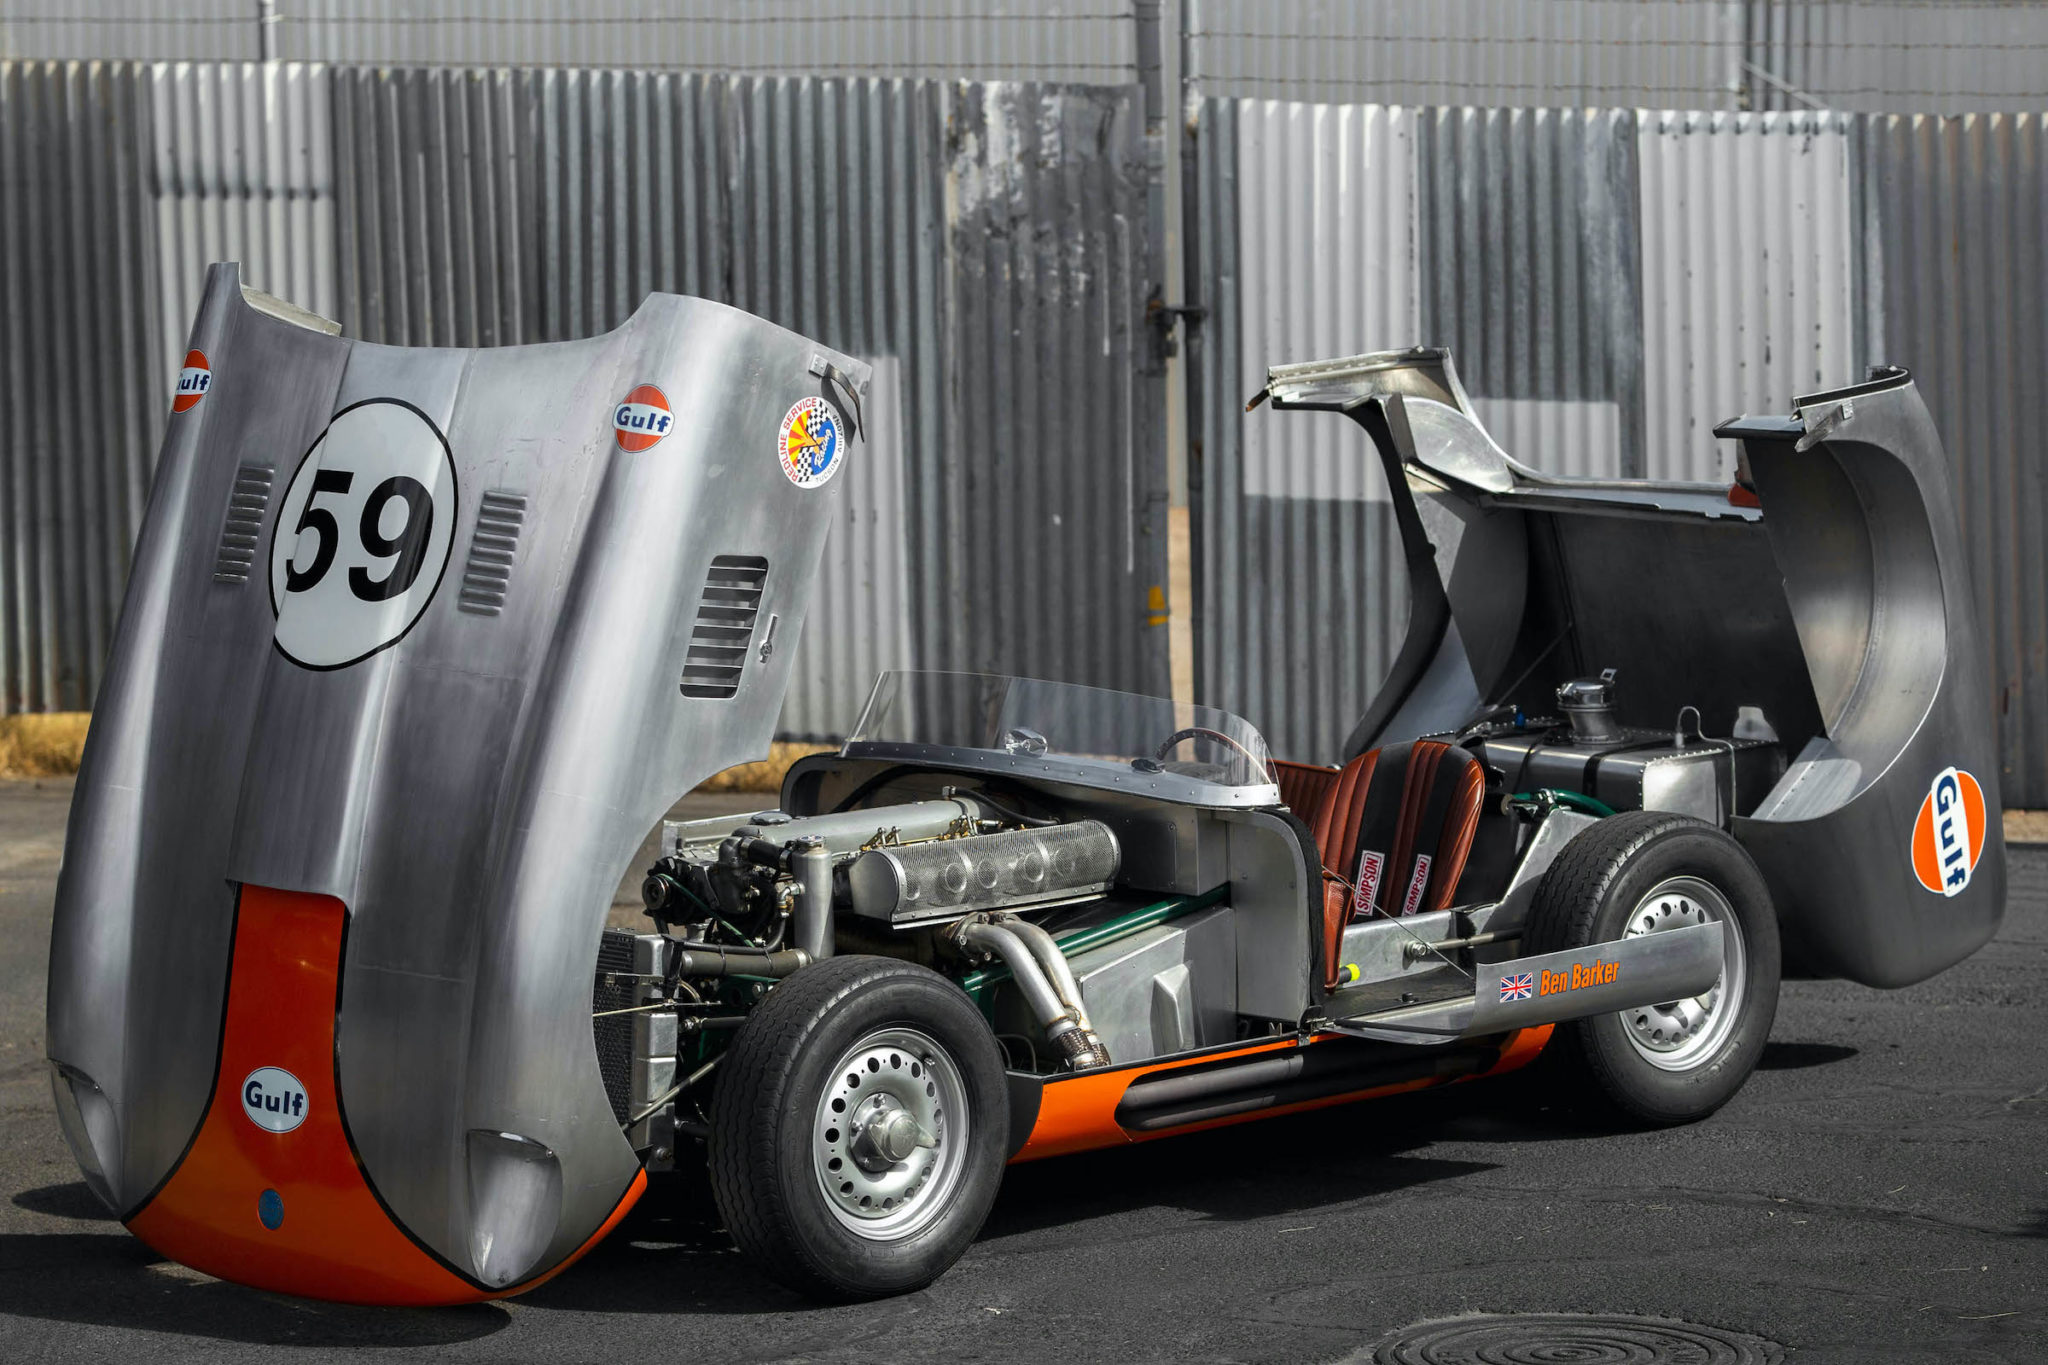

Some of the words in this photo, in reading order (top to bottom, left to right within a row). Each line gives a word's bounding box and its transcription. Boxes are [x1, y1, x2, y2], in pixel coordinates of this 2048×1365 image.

[177, 374, 210, 391] ulf
[616, 406, 671, 433] Gulf
[783, 397, 817, 430] SERVICE
[779, 433, 799, 482] REDLINE
[813, 429, 833, 469] Racing
[286, 469, 434, 602] 59
[1936, 775, 1966, 887] Gulf
[1357, 857, 1379, 910] SIMPSON
[1406, 861, 1428, 912] SIMPSON
[1539, 969, 1568, 997] Ben
[1571, 959, 1620, 991] Barker
[245, 1080, 303, 1117] Gulf
